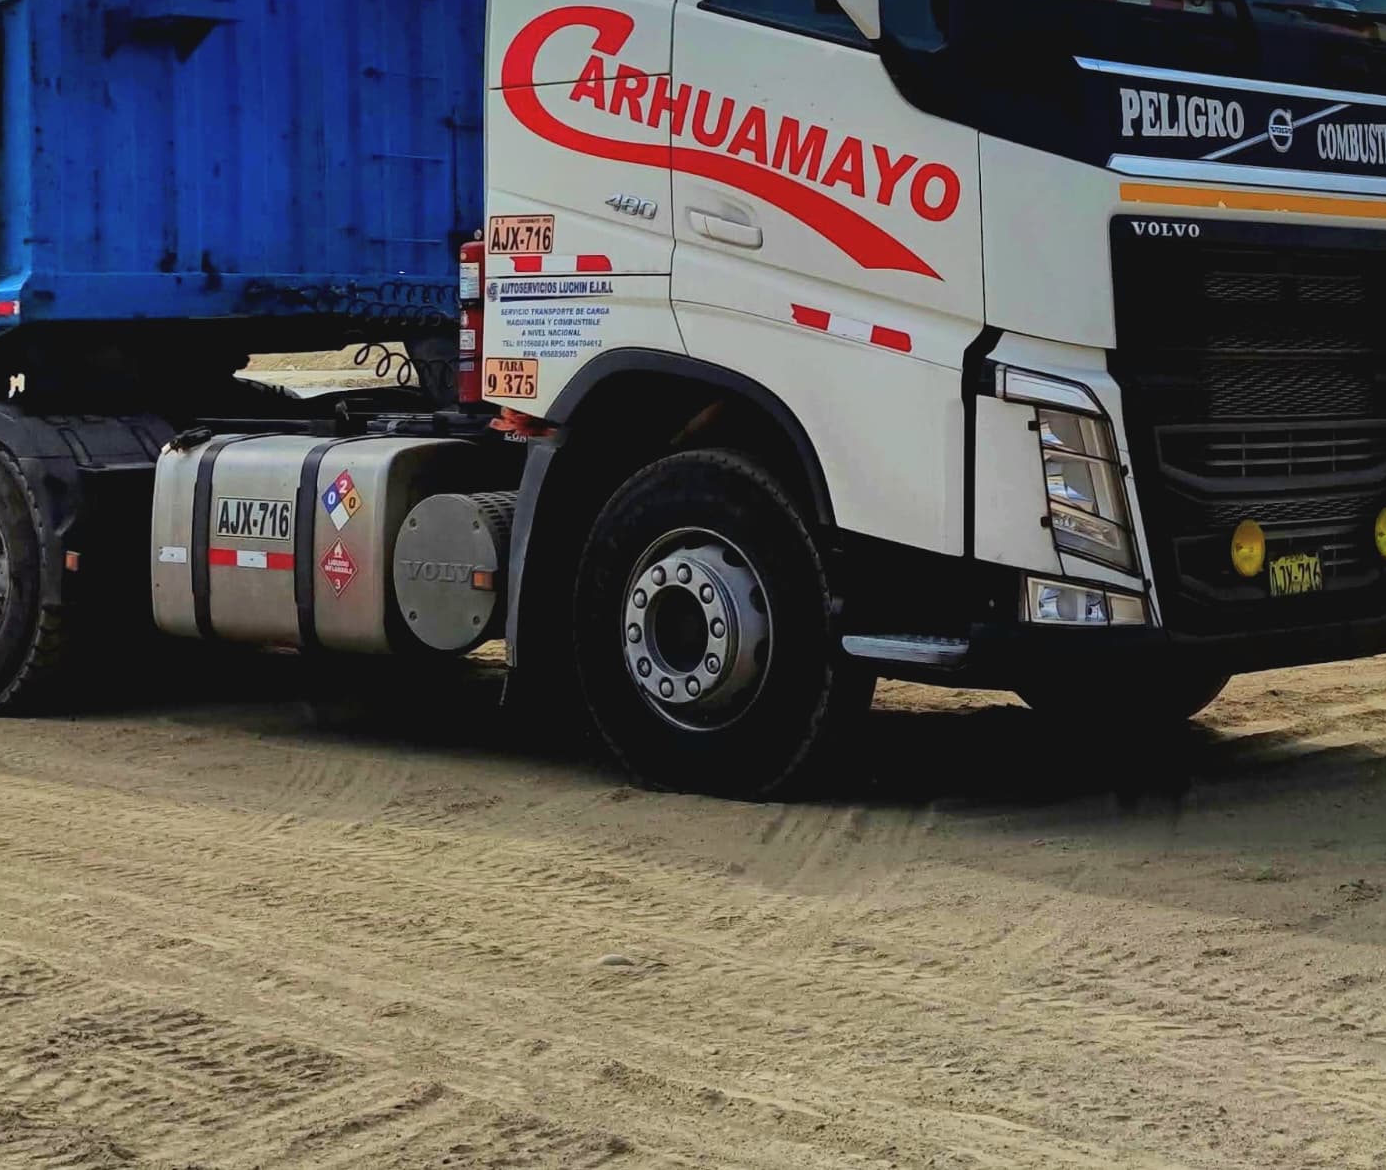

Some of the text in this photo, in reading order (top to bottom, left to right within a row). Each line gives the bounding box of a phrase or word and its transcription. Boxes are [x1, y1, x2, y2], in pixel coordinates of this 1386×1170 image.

[501, 5, 961, 223] CARHUAMAYO
[1119, 88, 1245, 140] PELIGRO
[1131, 221, 1201, 238] VOLVO
[491, 226, 552, 251] AJX-716
[500, 281, 557, 295] AUTOSERVICIOS
[500, 307, 611, 316] SERVICIO TRANSPORTE DE CARGA
[553, 318, 602, 326] COMBUSTIBLE
[498, 360, 524, 371] TARA
[487, 373, 535, 395] 9 375
[338, 479, 348, 494] 2
[327, 491, 356, 509] 0 0
[217, 500, 290, 536] AJX-716
[399, 560, 474, 583] VOLV
[334, 578, 341, 590] 3
